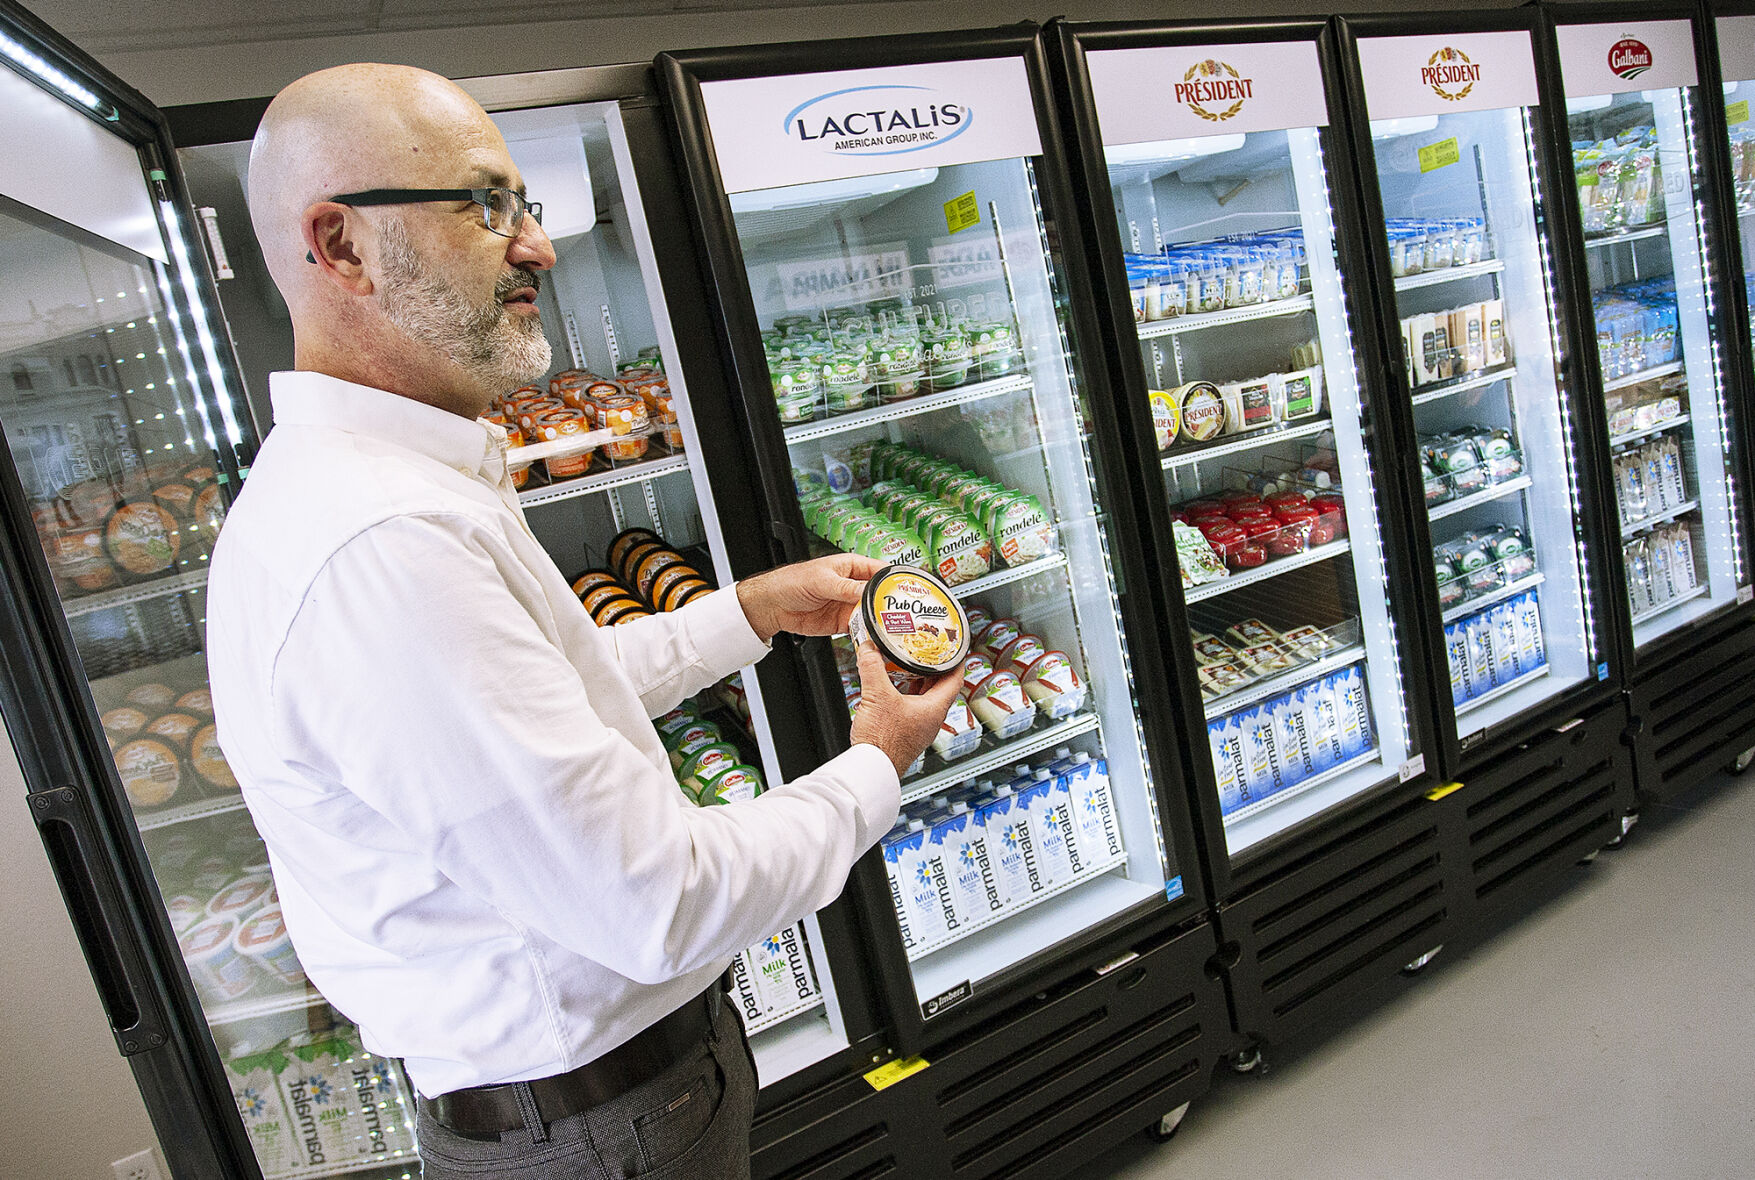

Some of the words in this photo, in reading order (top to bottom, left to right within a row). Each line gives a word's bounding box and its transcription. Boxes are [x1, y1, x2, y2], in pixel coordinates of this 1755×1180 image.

[1611, 49, 1649, 69] Galbani
[1420, 61, 1481, 86] PRÉSIDENT
[1173, 76, 1253, 106] PRÉSIDENT
[834, 137, 883, 151] AMERICAN
[1185, 404, 1222, 422] PRÉSIDENT
[1000, 511, 1042, 538] rondelé
[889, 545, 922, 566] ndelé
[937, 529, 982, 557] rondelé
[883, 595, 911, 611] Pub
[911, 599, 948, 615] Cheese
[1456, 640, 1474, 699] parmalat
[1352, 685, 1371, 747] parmalat
[1261, 722, 1284, 788] parmalat
[1293, 710, 1315, 775] parmalat
[1229, 735, 1252, 802] parmalat
[1094, 785, 1121, 857] parmalat
[1042, 834, 1063, 850] Milk
[1056, 802, 1084, 875] parmalat
[1000, 852, 1022, 868] Milk
[1015, 819, 1044, 893] parmalat
[957, 869, 980, 886] Milk
[972, 837, 1004, 912] parmalat
[914, 889, 937, 905] Milk
[930, 855, 961, 931] parmalat
[761, 958, 787, 976] Milk
[780, 927, 814, 1000] parmala
